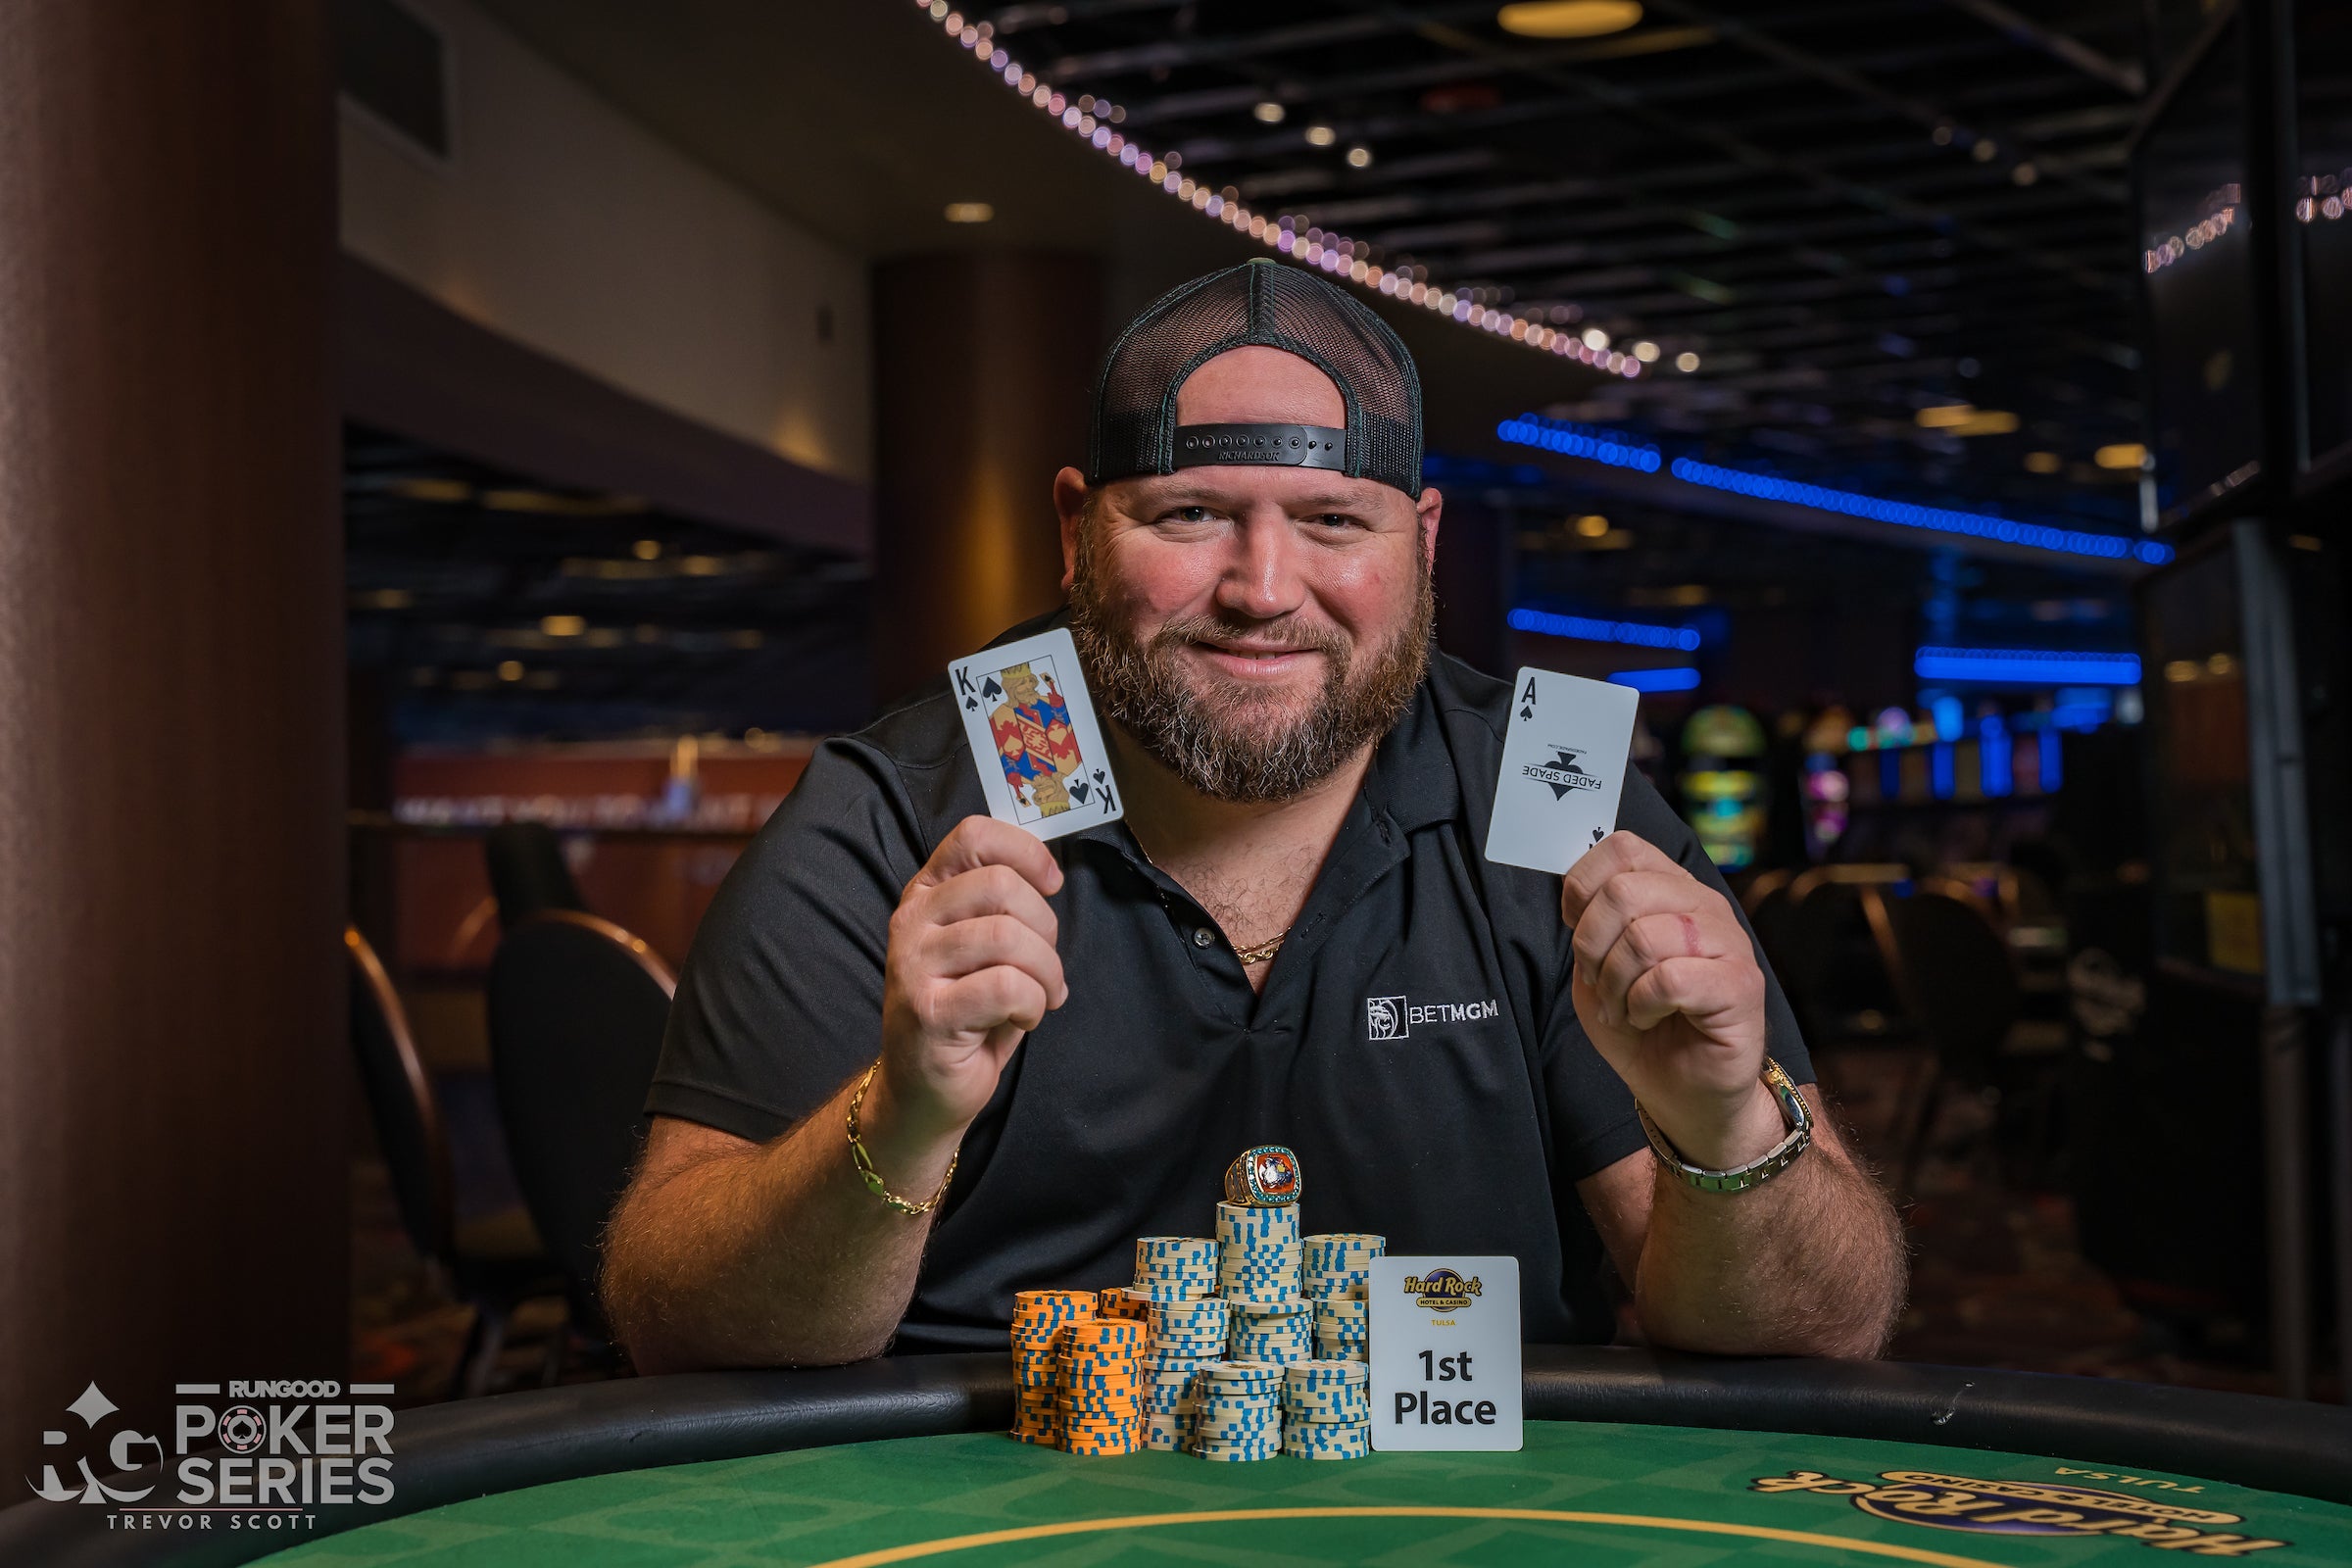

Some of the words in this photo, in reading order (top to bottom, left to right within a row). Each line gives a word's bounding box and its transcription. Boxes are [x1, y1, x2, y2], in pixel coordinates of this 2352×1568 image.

[955, 666, 976, 695] K
[1521, 676, 1537, 705] A
[1522, 765, 1560, 781] SPADE
[1562, 773, 1602, 790] FADED
[1096, 785, 1116, 814] K
[1409, 999, 1499, 1024] BETMGM
[1403, 1276, 1442, 1294] Hard
[1445, 1276, 1482, 1296] Rock
[1418, 1350, 1473, 1382] 1st
[1395, 1391, 1496, 1425] Place
[1748, 1471, 2004, 1515] Rock
[1903, 1474, 2044, 1497] CASINO
[2054, 1467, 2205, 1494] TULSA
[2091, 1500, 2215, 1520] HOTEL
[1968, 1509, 2293, 1555] Hard
